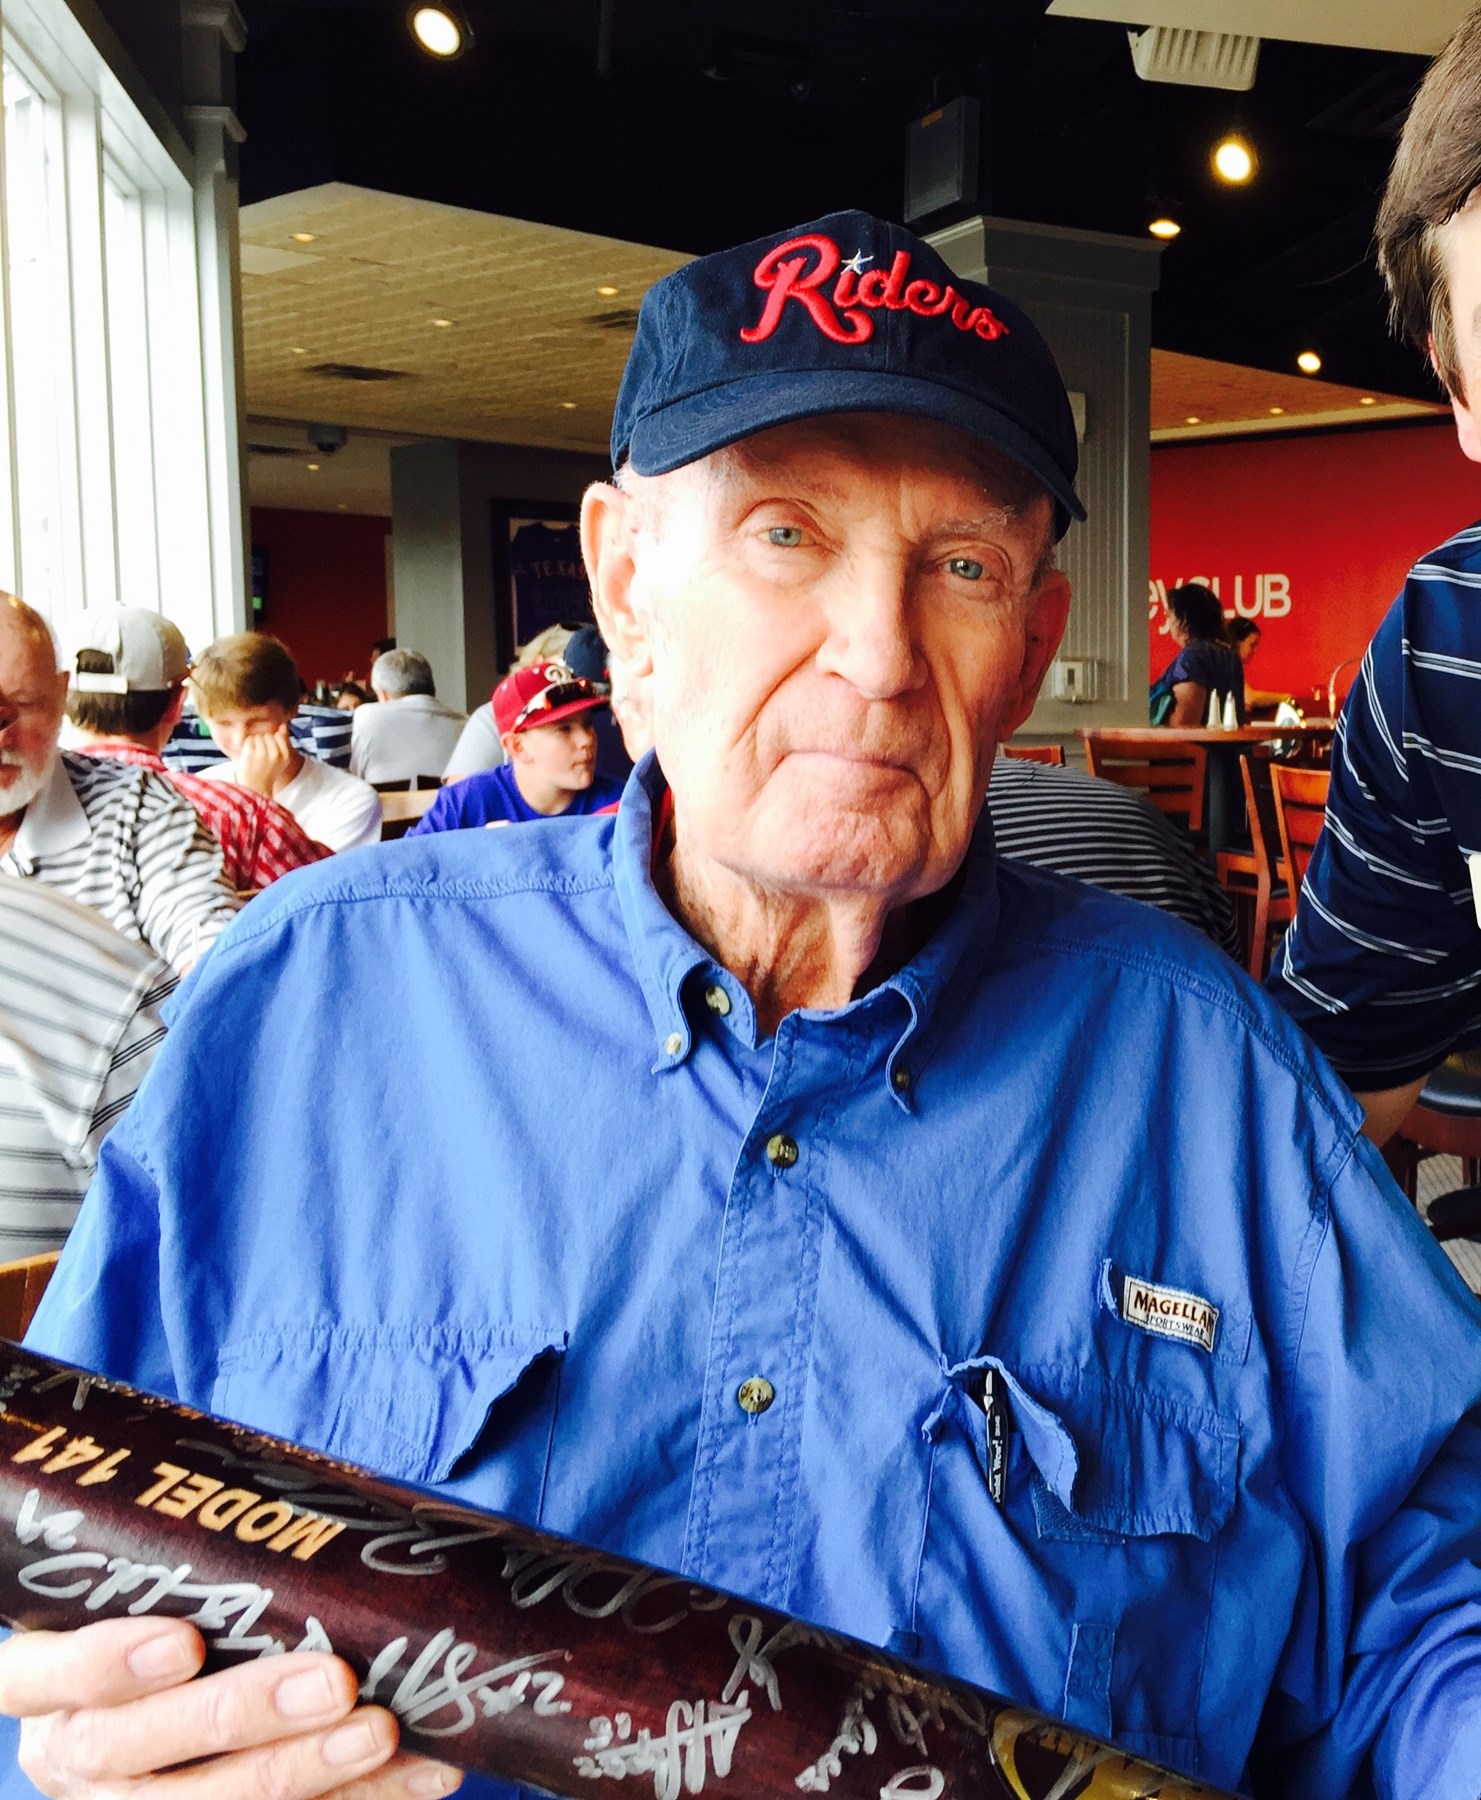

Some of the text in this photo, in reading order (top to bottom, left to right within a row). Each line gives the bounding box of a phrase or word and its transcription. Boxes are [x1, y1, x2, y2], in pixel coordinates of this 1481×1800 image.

[740, 234, 1010, 344] Riders
[1133, 1290, 1215, 1334] MAGELLAN
[11, 1425, 131, 1486] 141
[135, 1462, 348, 1561] MODEL
